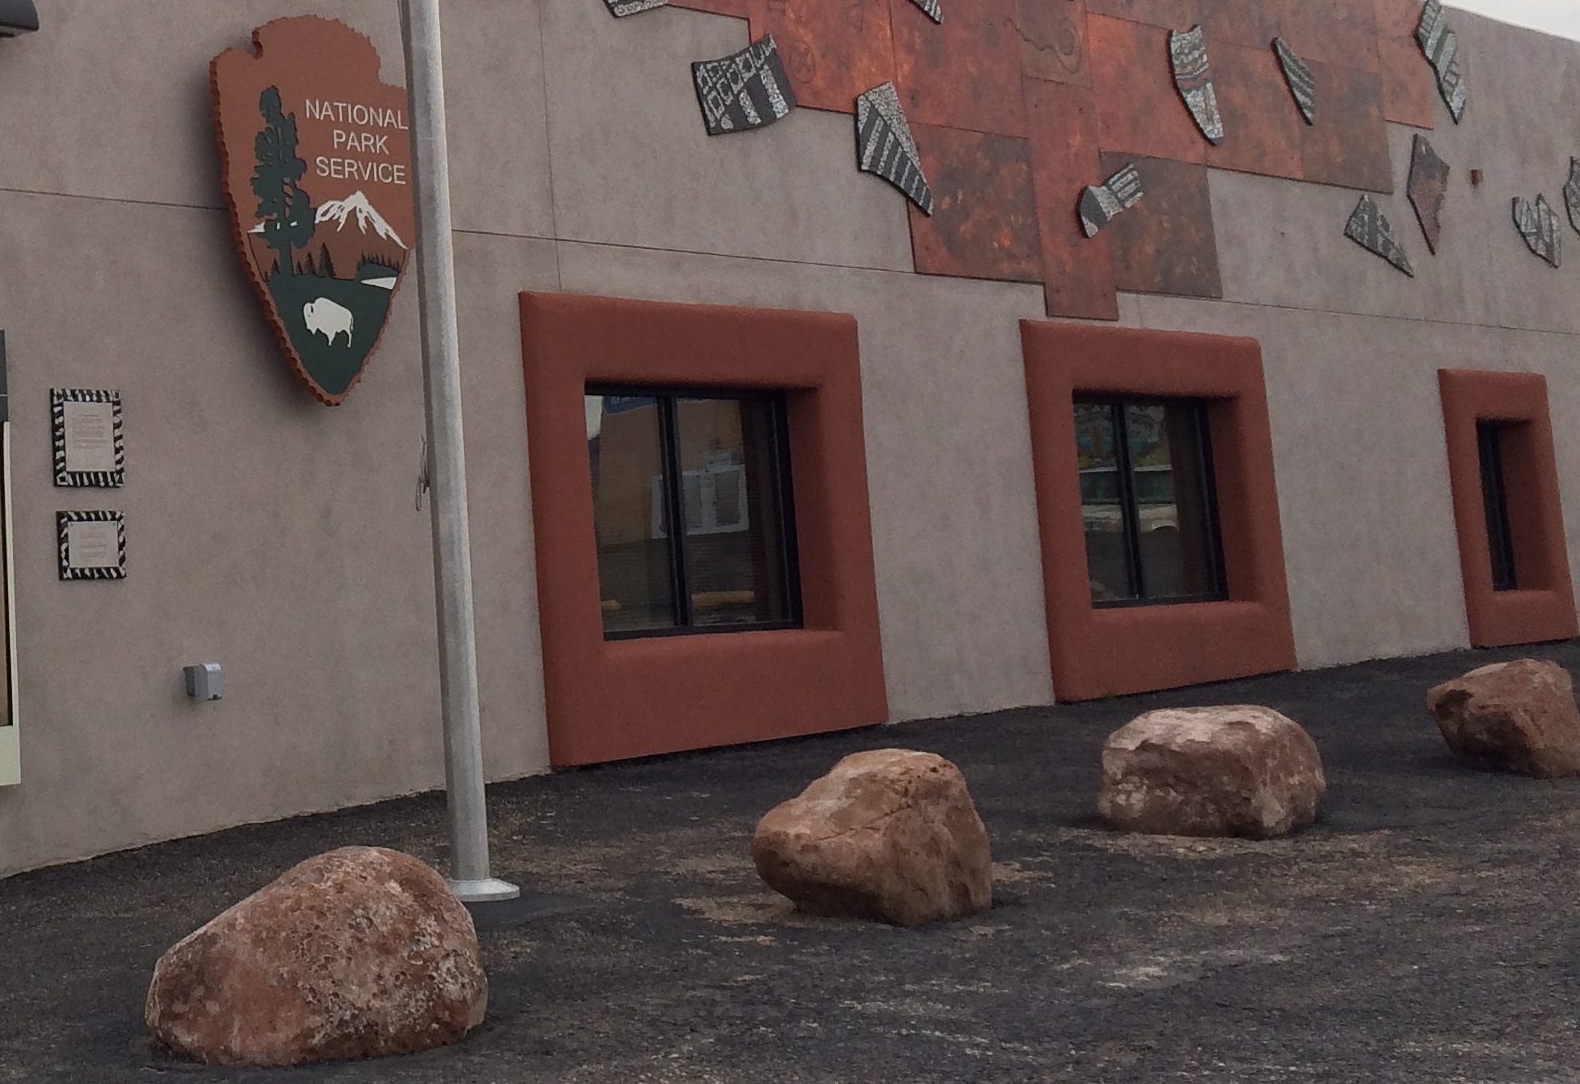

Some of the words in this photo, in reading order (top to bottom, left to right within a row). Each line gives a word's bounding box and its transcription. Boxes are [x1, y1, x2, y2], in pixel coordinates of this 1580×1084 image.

[305, 98, 409, 130] NATIONAL
[333, 129, 389, 155] PARK
[316, 156, 406, 184] SERVICE
